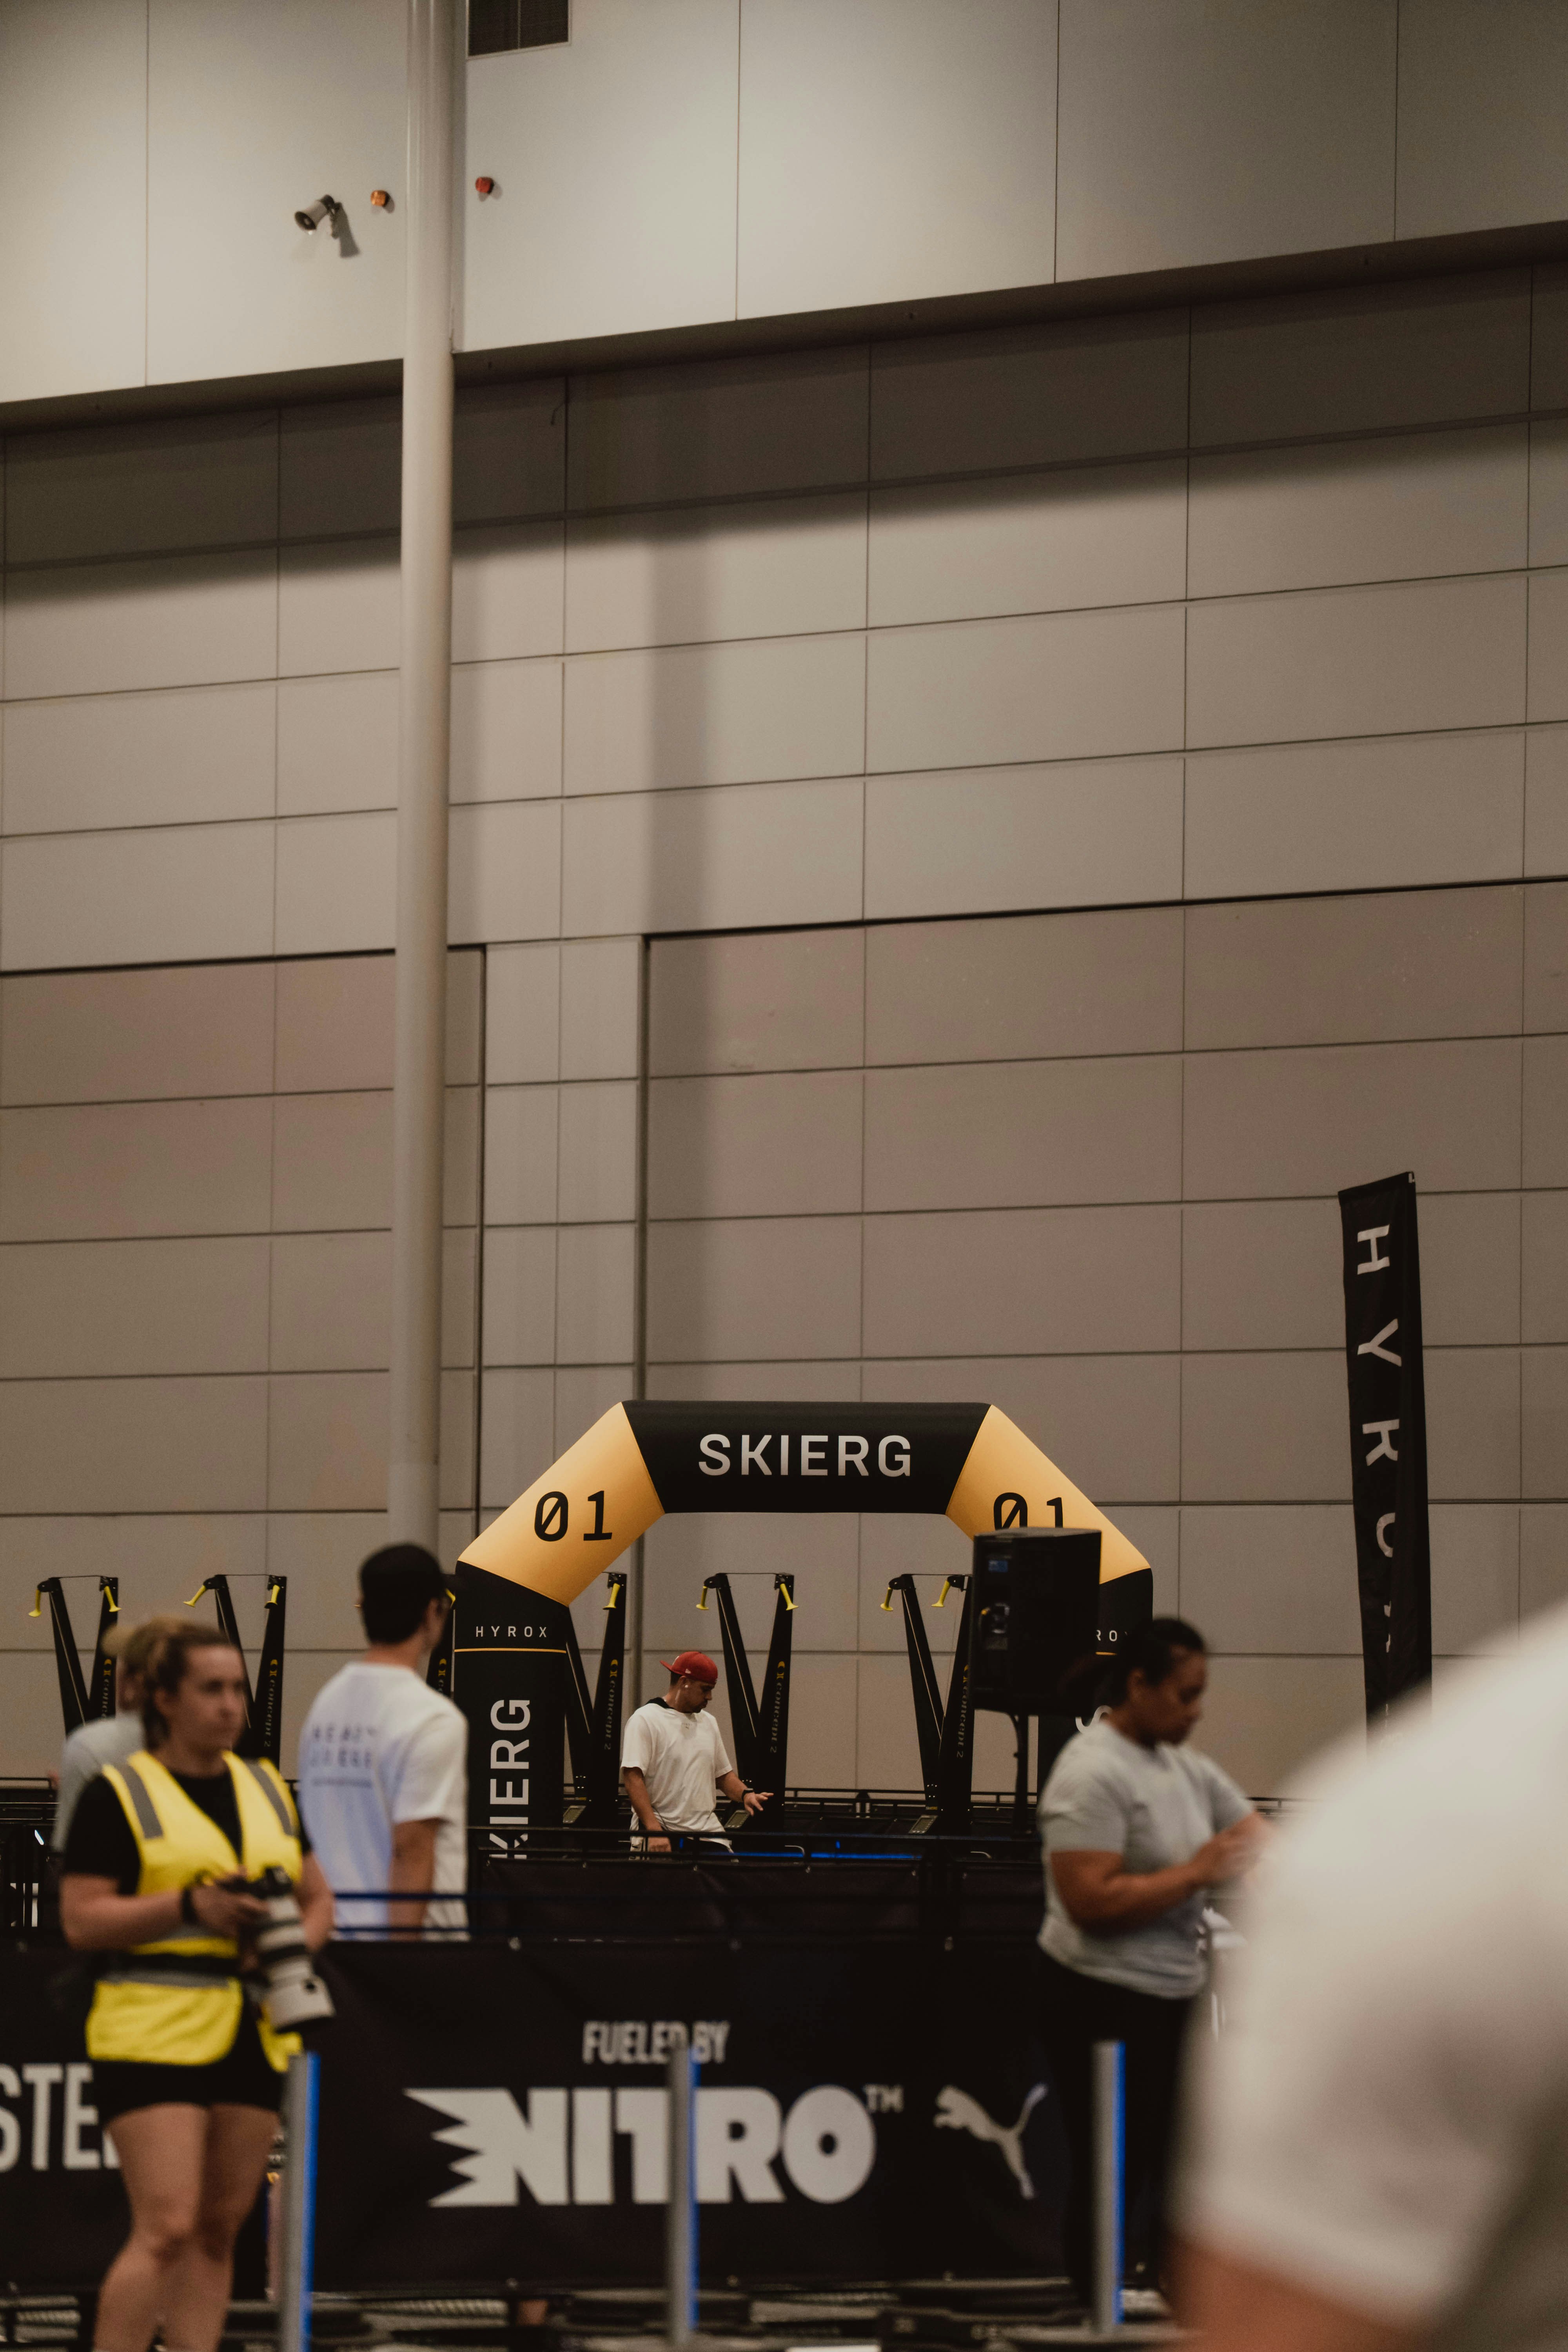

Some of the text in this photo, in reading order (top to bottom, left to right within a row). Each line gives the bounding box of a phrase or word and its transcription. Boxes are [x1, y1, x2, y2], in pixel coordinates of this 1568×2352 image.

[698, 1433, 911, 1477] SKIERG
[534, 1490, 613, 1542] 01
[475, 1625, 547, 1638] HYROX
[691, 2021, 730, 2064] BY
[0, 2063, 120, 2172] STE
